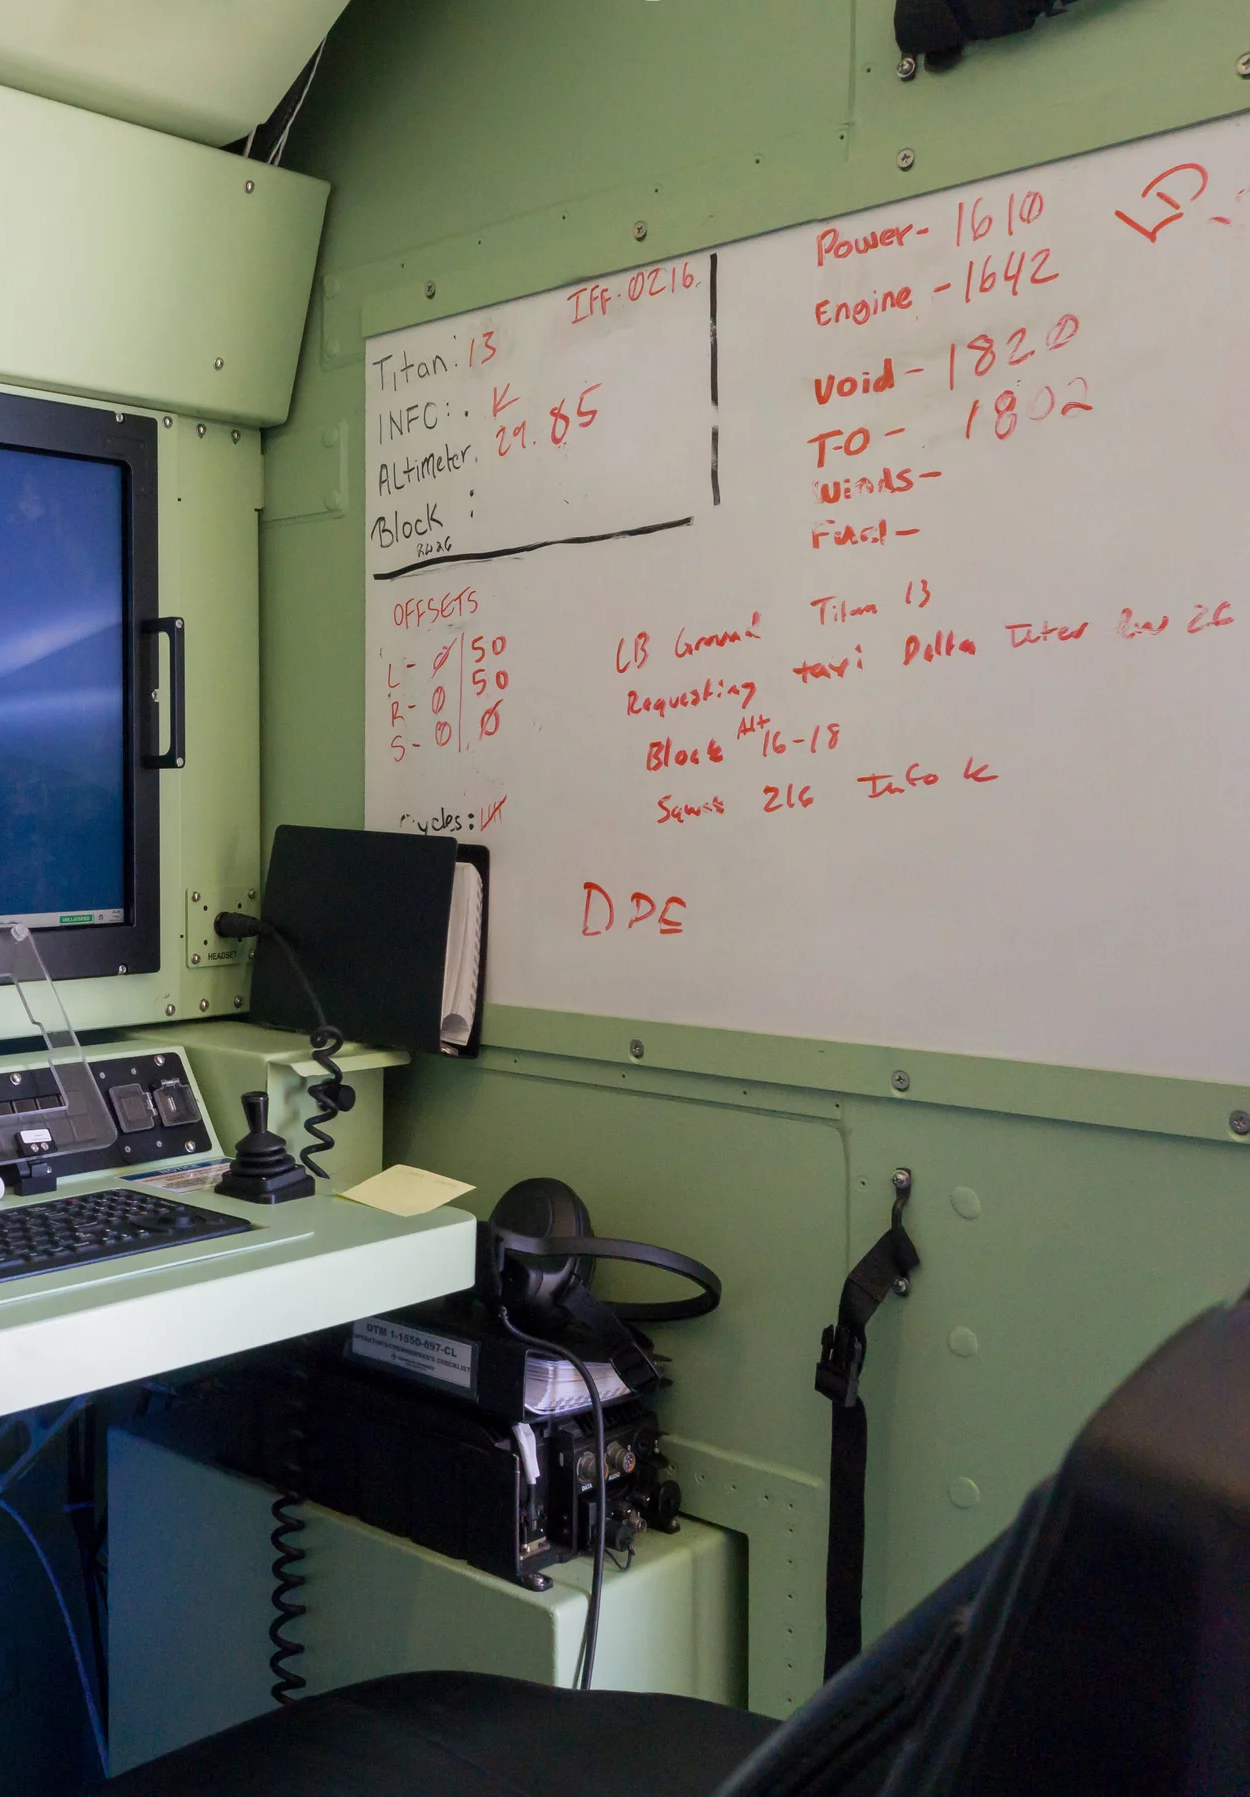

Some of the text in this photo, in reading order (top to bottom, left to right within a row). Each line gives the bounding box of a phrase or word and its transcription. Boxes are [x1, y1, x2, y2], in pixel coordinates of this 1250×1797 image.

[956, 190, 1043, 246] 1610
[815, 284, 912, 326] Engine
[468, 331, 497, 367] 13
[371, 503, 444, 548] Block
[394, 586, 478, 629] OFFSETS
[905, 579, 931, 608] 13
[472, 636, 506, 663] 50
[472, 669, 509, 696] 50
[436, 1358, 470, 1373] CHECKLIST
[582, 1483, 592, 1491] DATA
[609, 1472, 620, 1480] AUDIO
